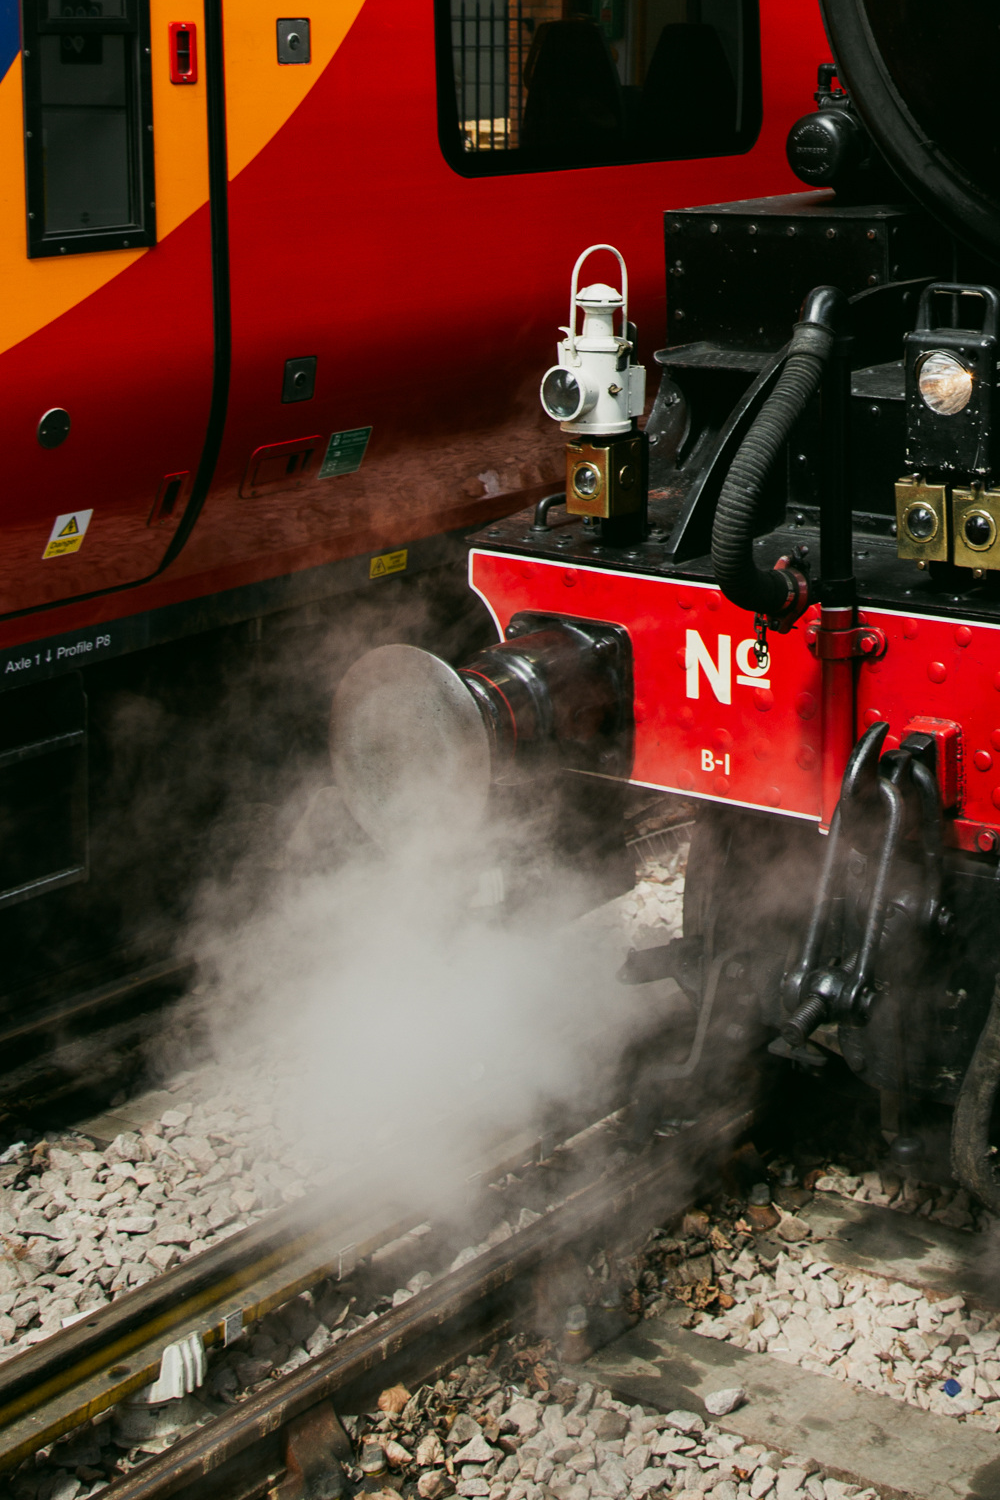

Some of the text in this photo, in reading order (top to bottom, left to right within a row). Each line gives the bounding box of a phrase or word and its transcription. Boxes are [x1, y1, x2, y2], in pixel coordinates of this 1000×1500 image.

[4, 634, 111, 674] Axle 1 Profile P8
